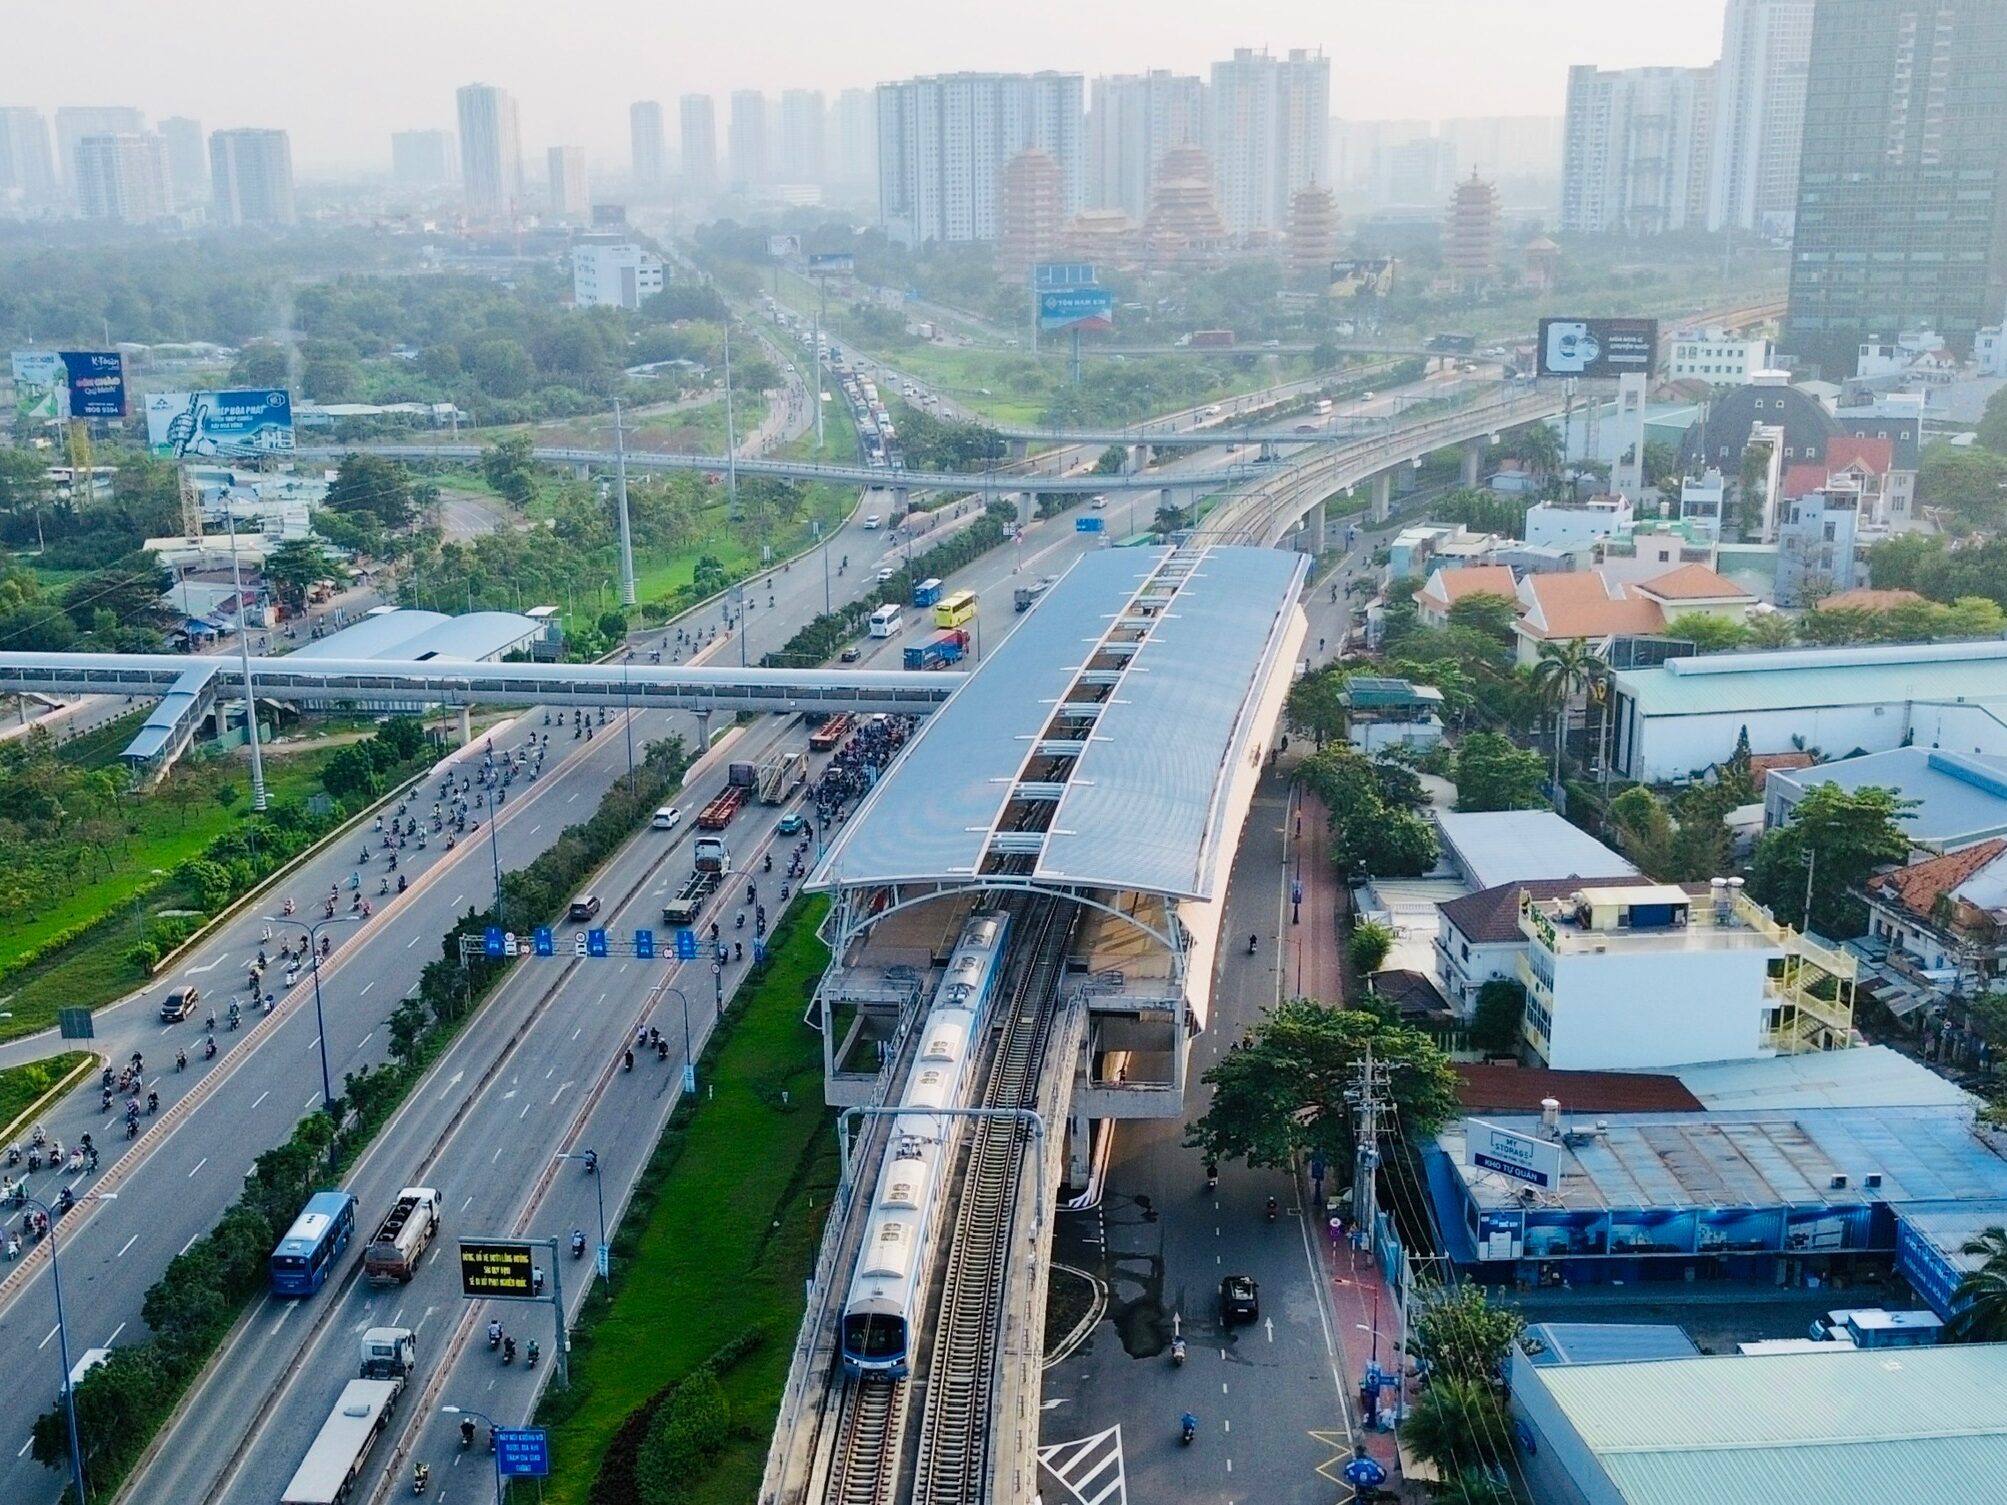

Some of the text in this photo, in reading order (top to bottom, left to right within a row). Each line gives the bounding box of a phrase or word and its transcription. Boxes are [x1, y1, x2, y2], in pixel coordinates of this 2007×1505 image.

[1506, 1138, 1517, 1147] MY
[1495, 1143, 1529, 1159] STORAGE
[1484, 1158, 1501, 1170] KHO
